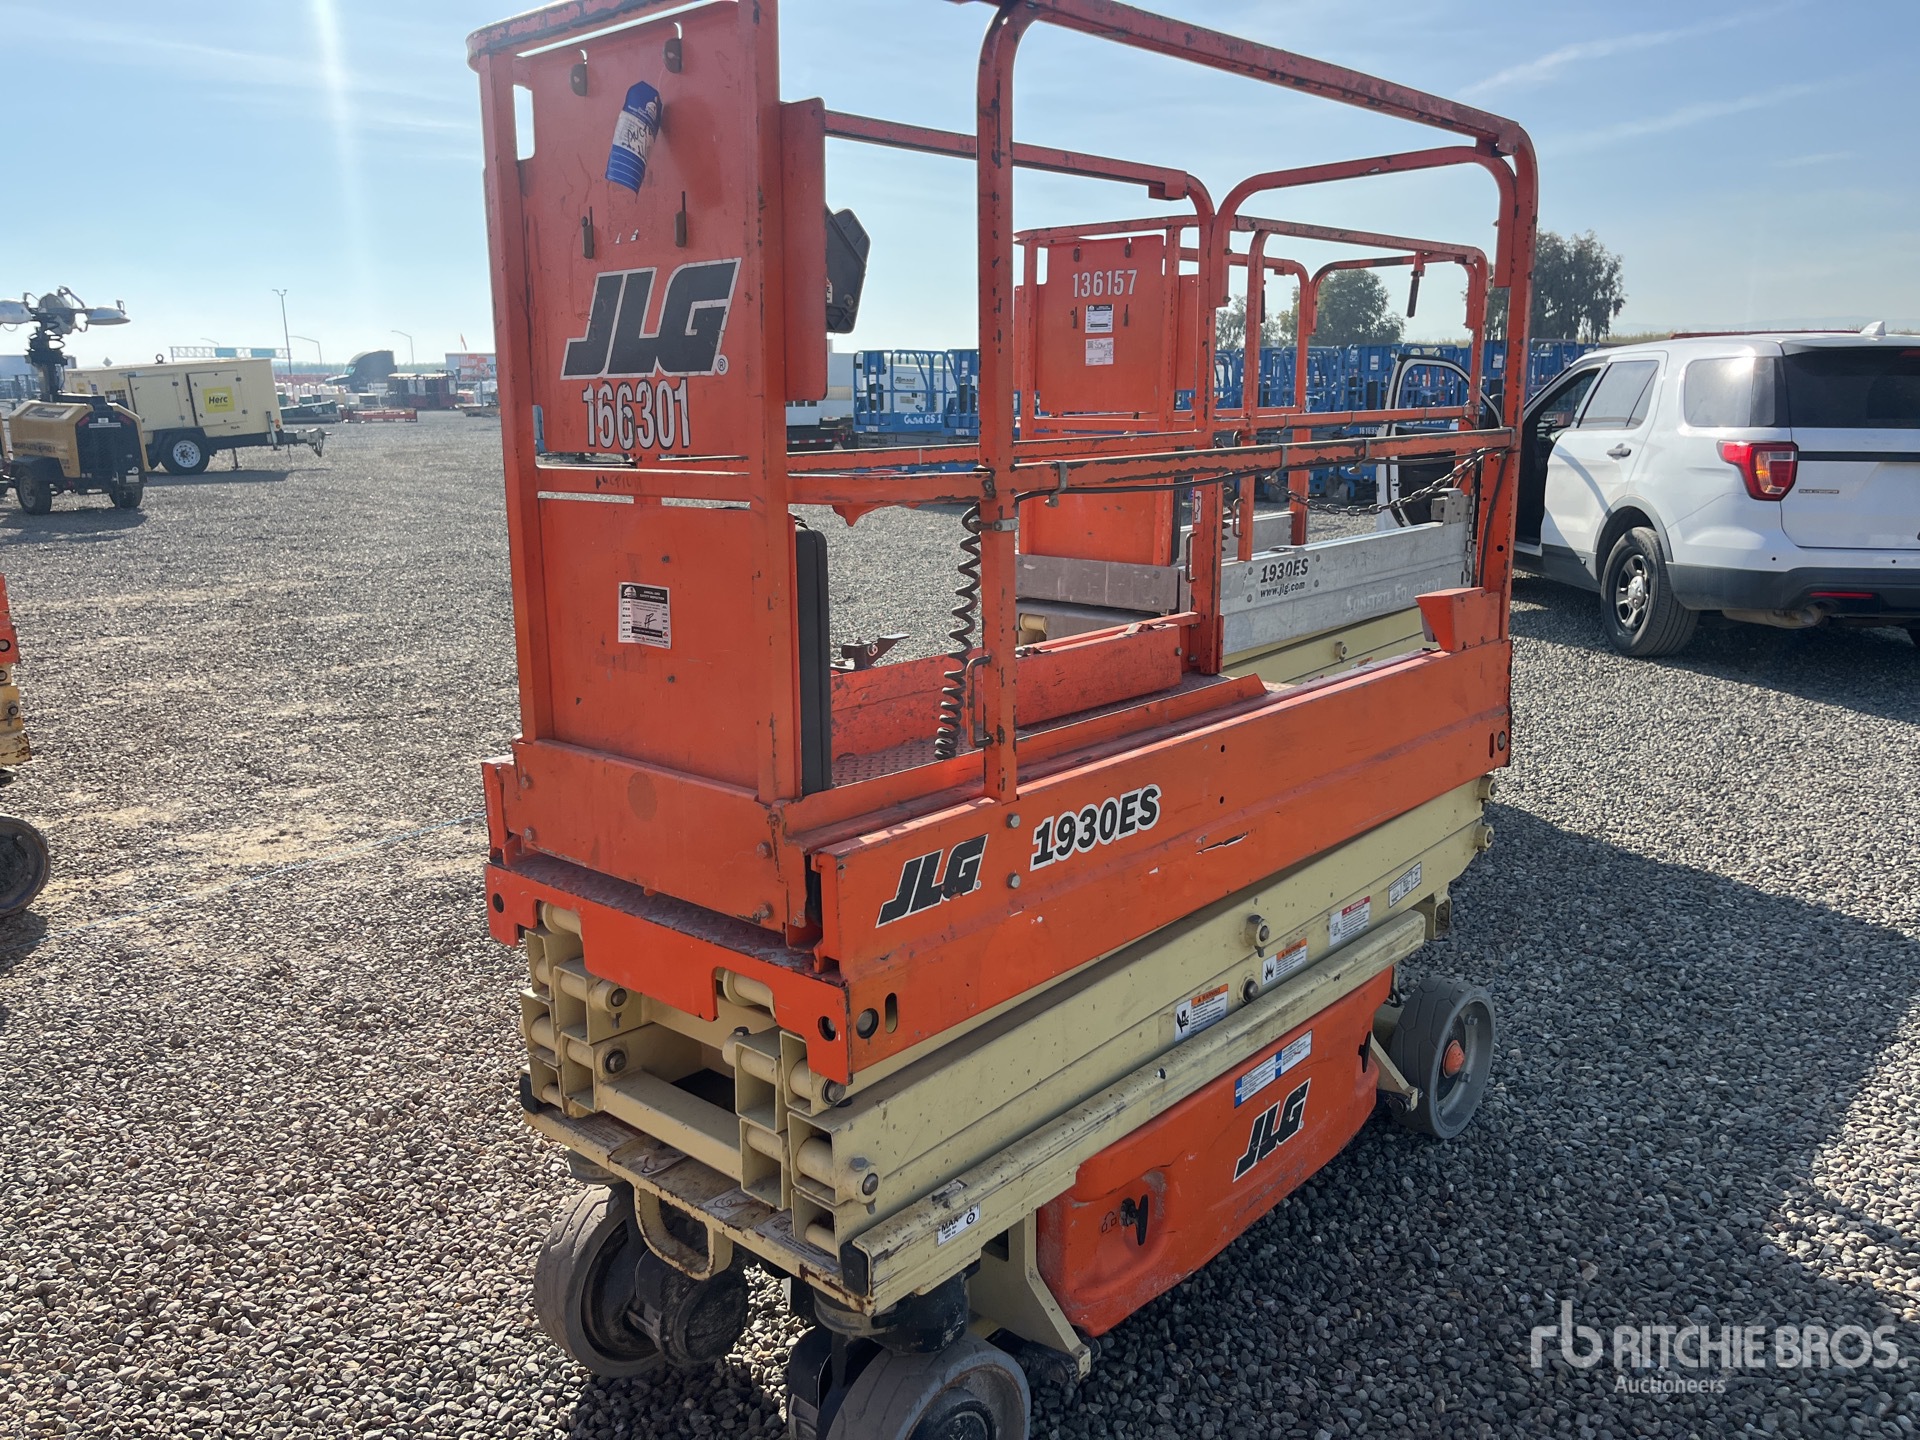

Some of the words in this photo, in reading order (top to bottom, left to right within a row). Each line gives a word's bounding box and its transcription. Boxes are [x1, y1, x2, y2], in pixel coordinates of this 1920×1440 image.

[560, 257, 742, 380] JLG
[1072, 269, 1138, 298] 136157
[208, 395, 229, 405] Herc
[581, 377, 691, 451] 166301
[1260, 557, 1309, 584] 1930ES
[1260, 580, 1305, 598] www.jlg.com
[1029, 783, 1162, 871] 1930ES
[875, 833, 989, 929] JLG
[1232, 1077, 1312, 1183] JLG
